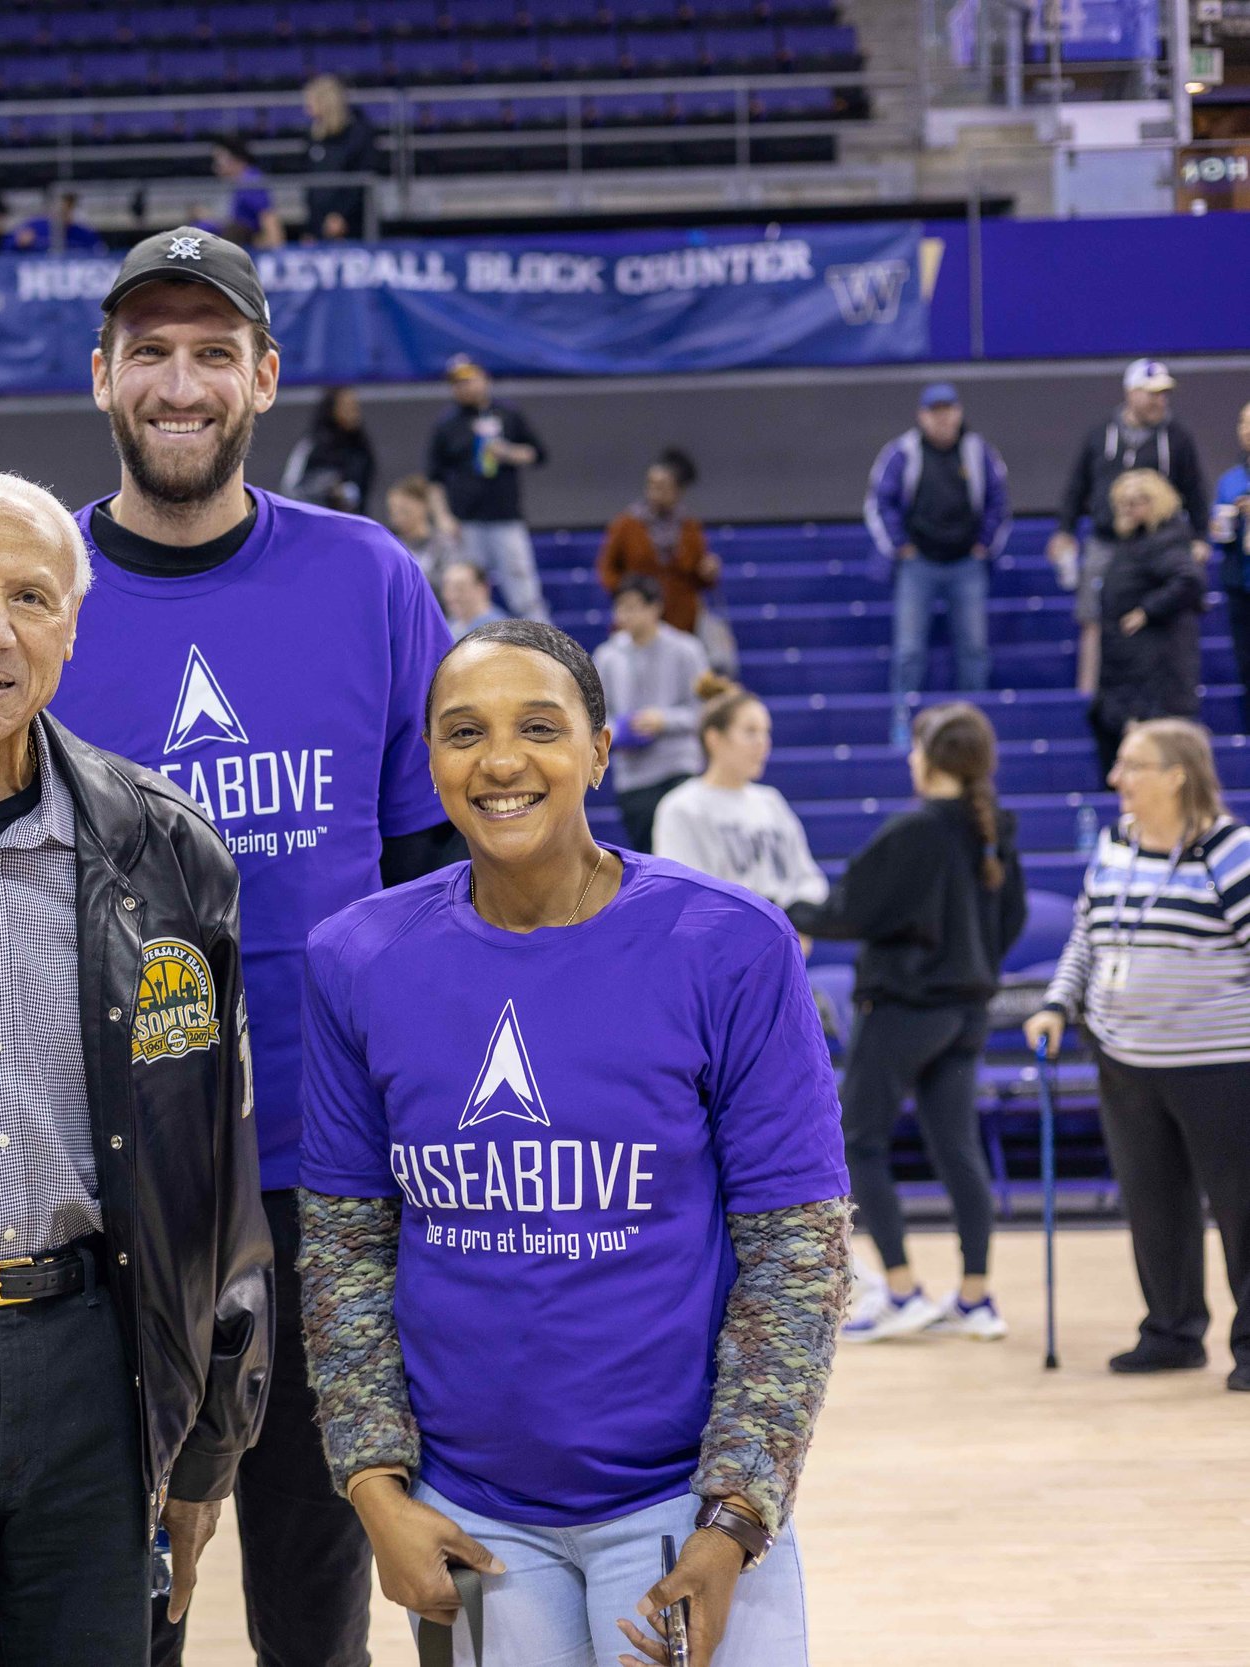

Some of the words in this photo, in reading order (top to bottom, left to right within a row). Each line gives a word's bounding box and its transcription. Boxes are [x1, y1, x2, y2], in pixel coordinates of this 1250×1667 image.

[17, 258, 121, 300] HUS
[257, 249, 458, 292] LEYBALL
[466, 250, 604, 294] BLOCK
[615, 239, 815, 295] COUNTER
[826, 259, 910, 326] W
[147, 749, 335, 822] ABOVE
[225, 828, 278, 857] being
[142, 946, 187, 966] VERSARY
[184, 954, 208, 995] SEASON
[135, 1000, 210, 1042] SONICS
[145, 1040, 164, 1055] 1967
[189, 1031, 208, 1042] 2007
[390, 1139, 657, 1213] RISEABOVE
[426, 1214, 443, 1246] be
[447, 1230, 456, 1248] a
[461, 1228, 492, 1255] pro
[497, 1225, 517, 1254] at
[522, 1223, 580, 1260] being
